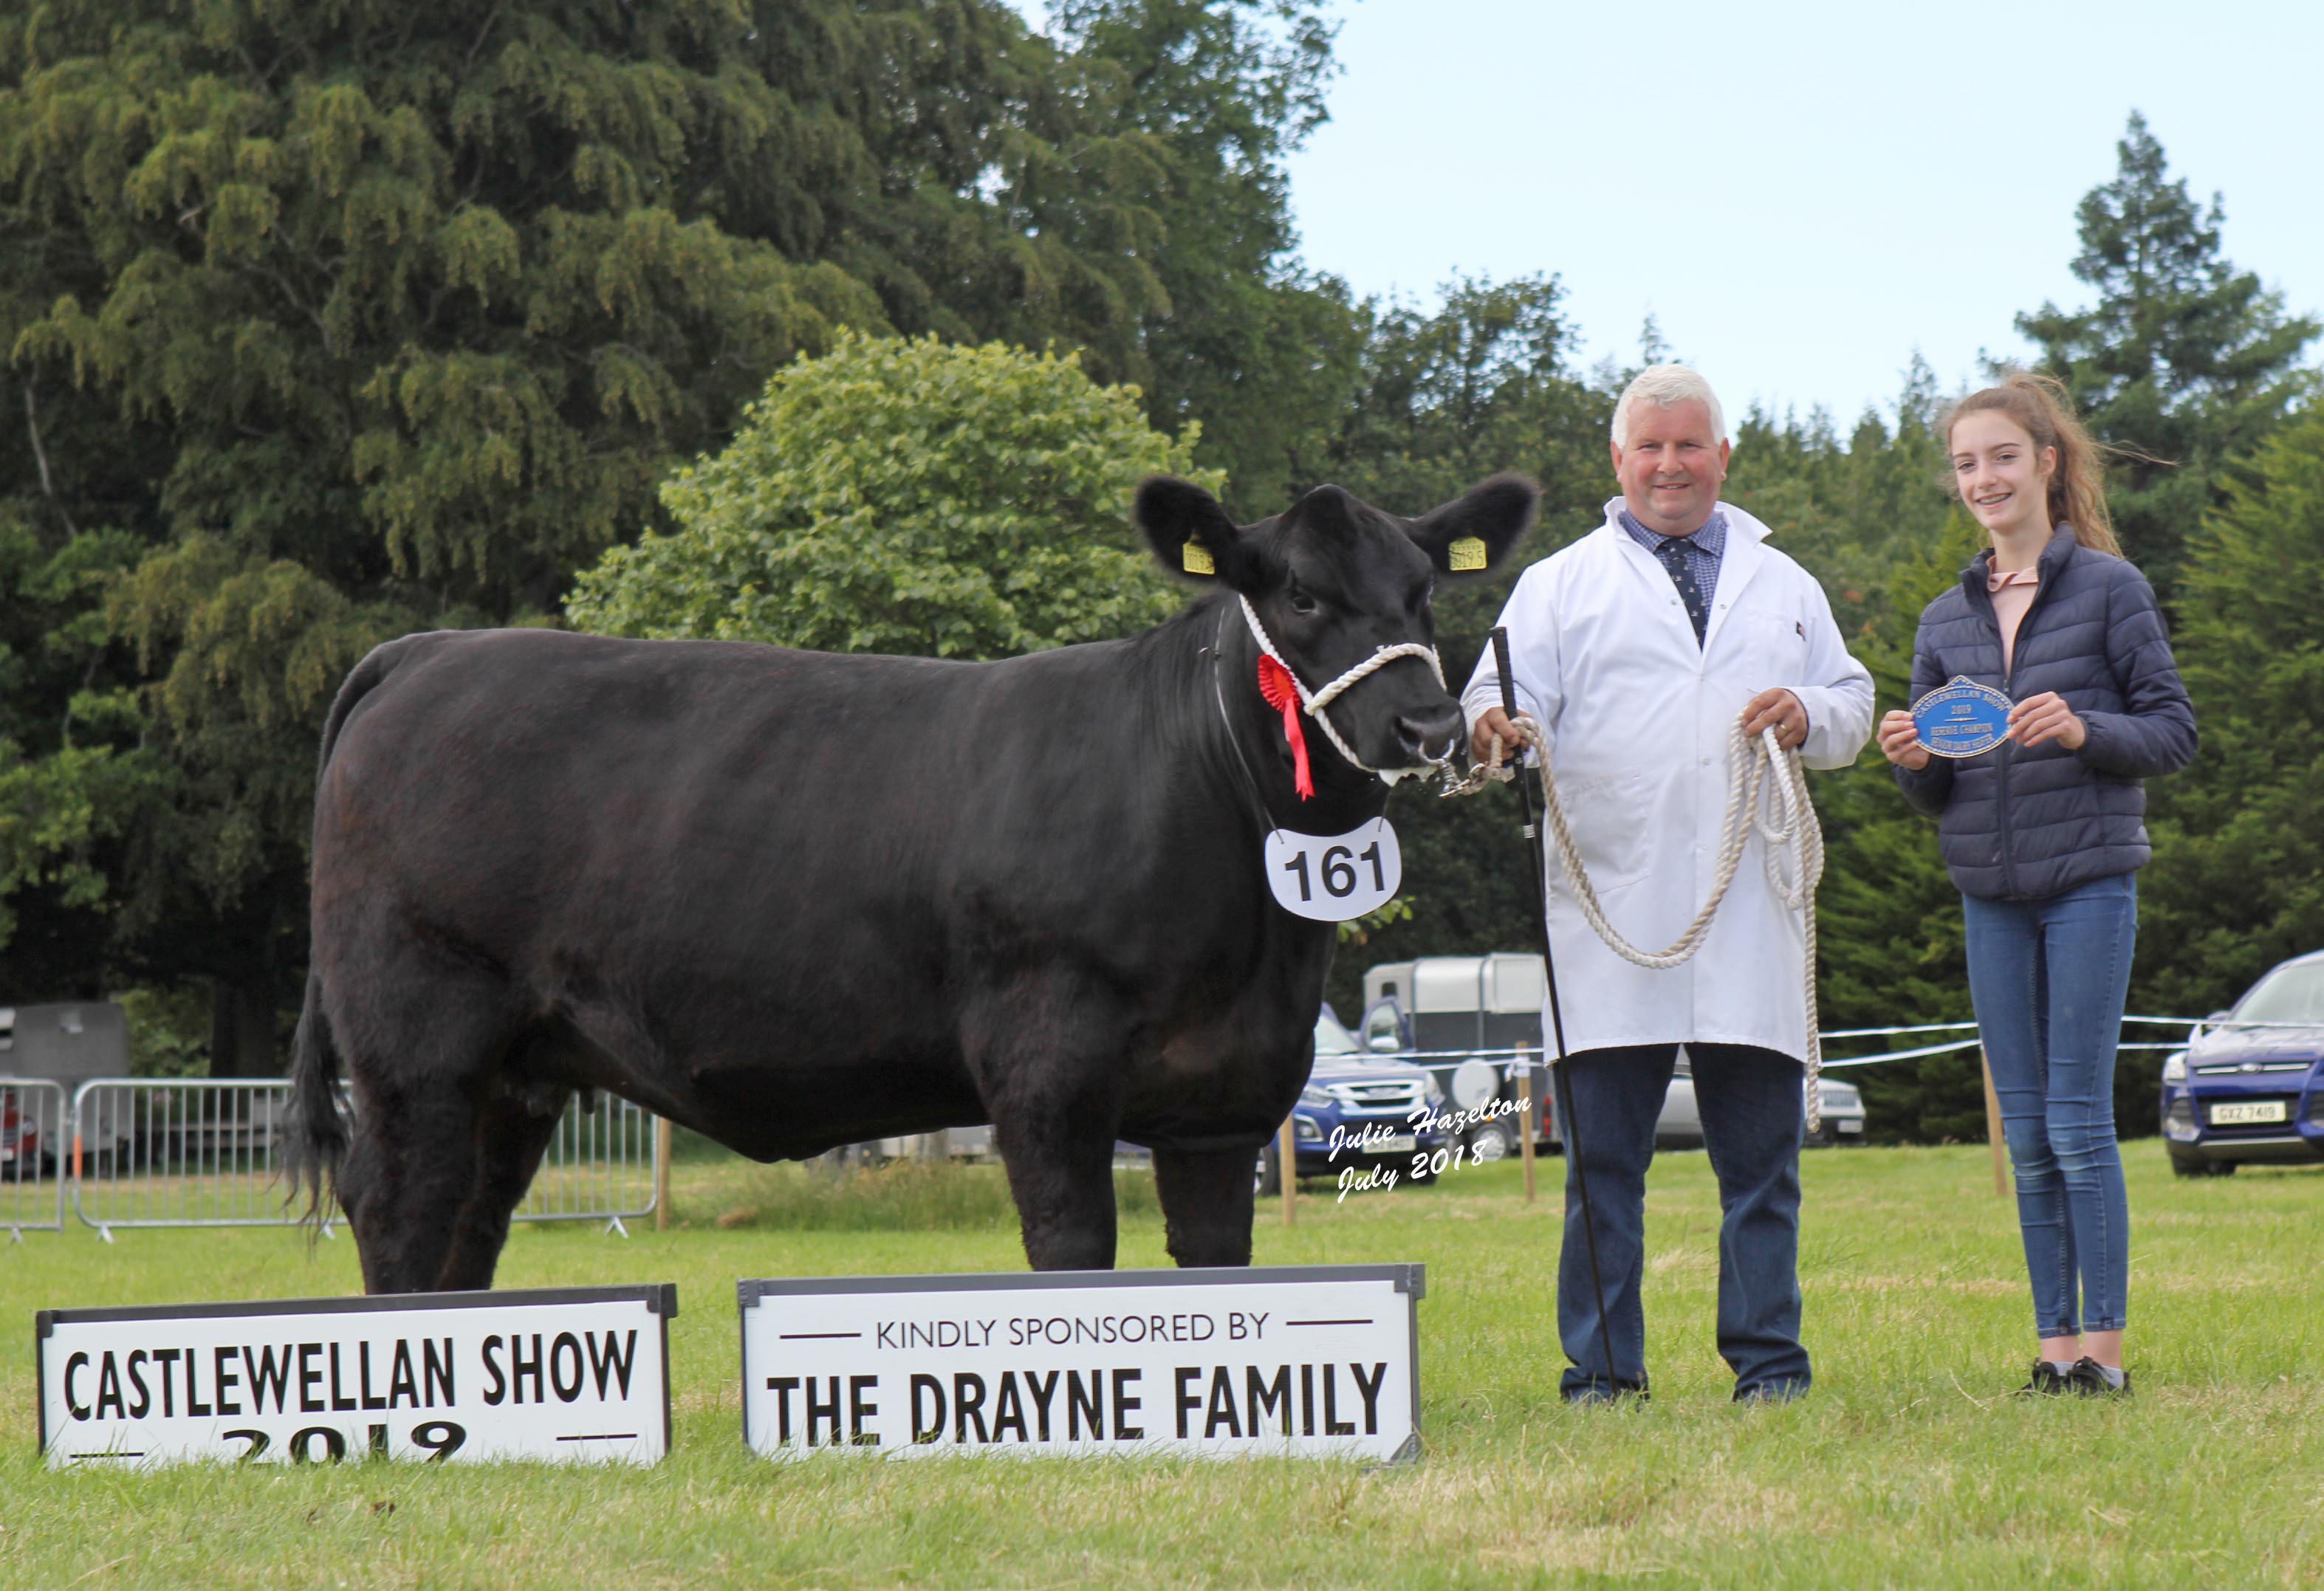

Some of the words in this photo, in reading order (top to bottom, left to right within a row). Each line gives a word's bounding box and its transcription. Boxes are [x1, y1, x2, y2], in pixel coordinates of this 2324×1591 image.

[1916, 690, 1981, 719] CASTLEWELLAN
[1284, 841, 1385, 901] 161
[877, 1321, 997, 1349] KINDLY
[1010, 1314, 1215, 1347] SPONSORED
[1230, 1313, 1270, 1340] BY
[64, 1336, 455, 1421] CASTLEWELLAN
[482, 1330, 637, 1406] SHOW
[767, 1375, 881, 1447] THE
[911, 1368, 1145, 1445] DRAYNE
[1176, 1362, 1388, 1439] FAMILY
[222, 1420, 467, 1465] 2019
